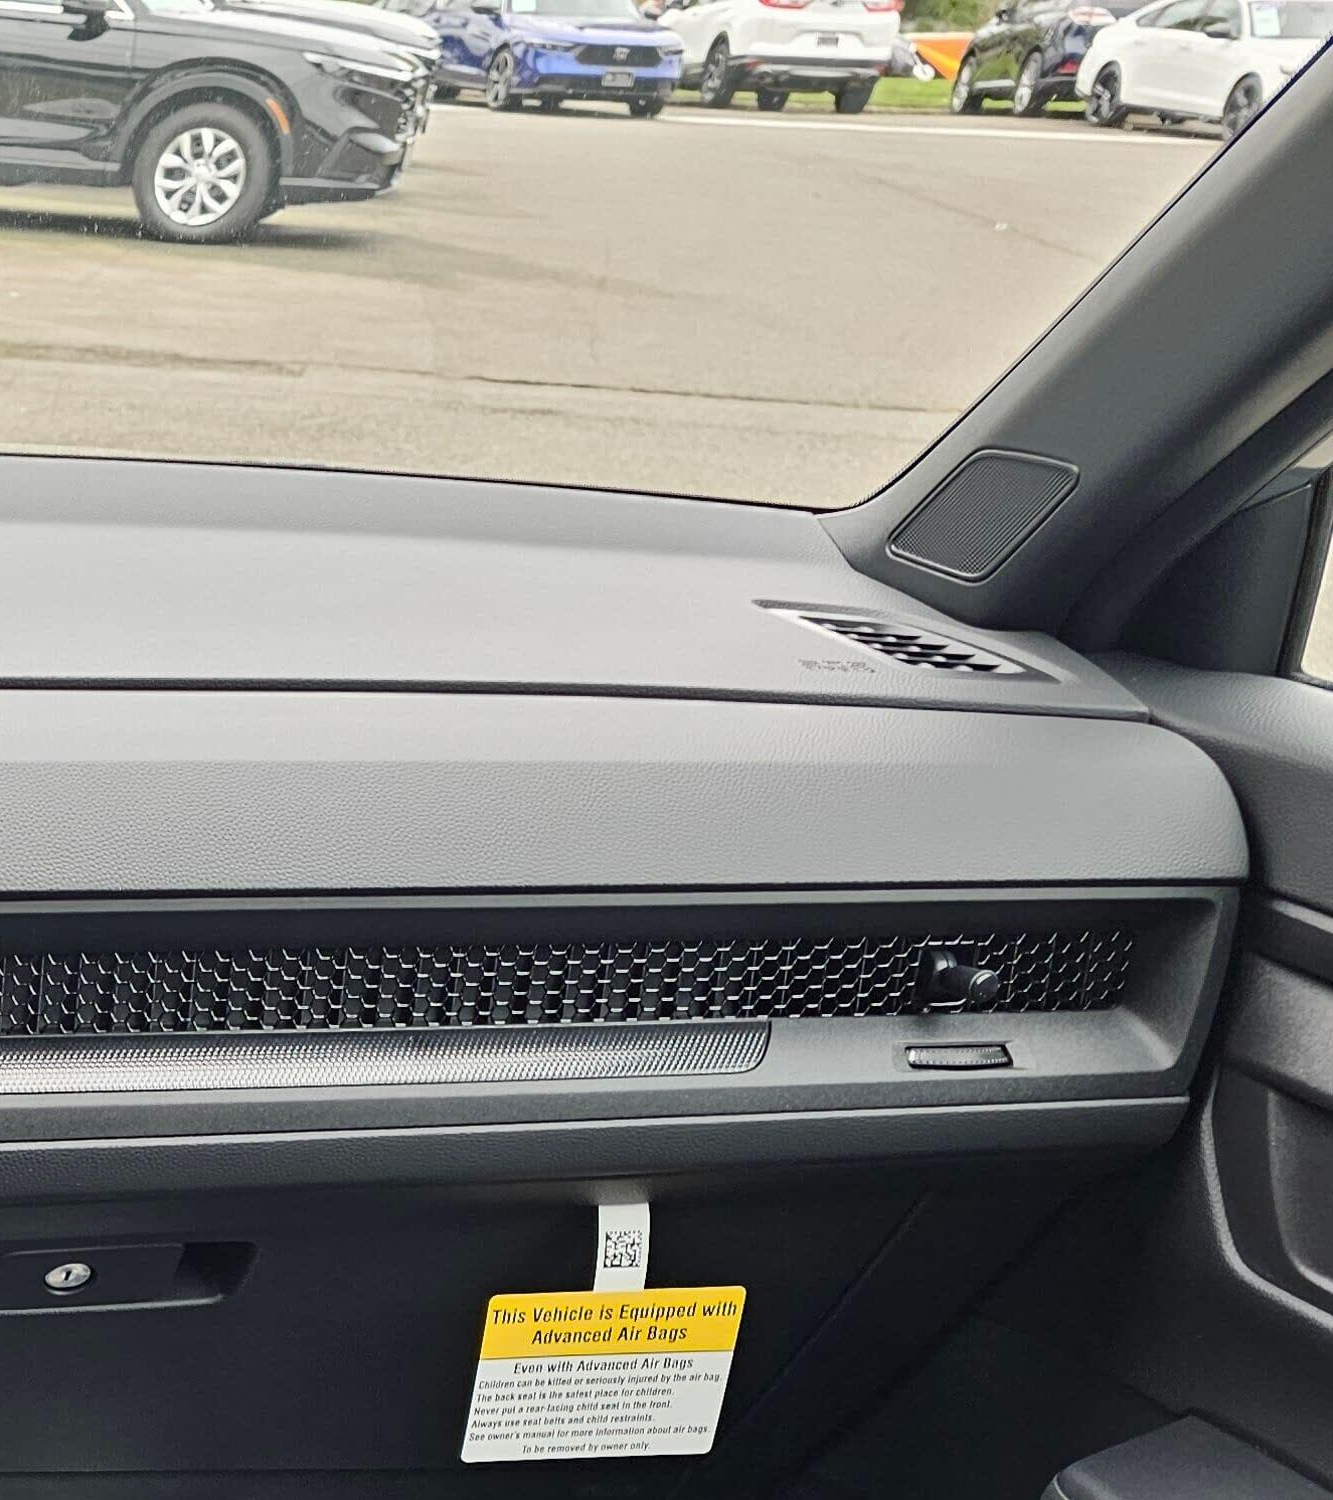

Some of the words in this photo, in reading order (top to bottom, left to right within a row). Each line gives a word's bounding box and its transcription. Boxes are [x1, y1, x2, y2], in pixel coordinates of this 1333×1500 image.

[493, 1309, 526, 1325] This
[533, 1306, 594, 1323] Vehicle
[600, 1305, 614, 1321] is
[619, 1303, 697, 1322] Equipped
[702, 1301, 738, 1317] with
[532, 1327, 612, 1345] Advanced
[617, 1326, 643, 1343] Air
[647, 1325, 688, 1343] Bags
[513, 1363, 543, 1374] Even
[547, 1361, 573, 1373] with
[576, 1358, 638, 1373] Advanced
[641, 1358, 660, 1370] Air
[663, 1357, 694, 1371] Bags
[479, 1379, 514, 1390] Children
[517, 1380, 532, 1388] can
[535, 1378, 545, 1387] be
[547, 1377, 572, 1386] killed
[586, 1375, 625, 1387] seriously
[628, 1374, 659, 1385] injured
[661, 1374, 671, 1384] by
[673, 1373, 686, 1381] the
[689, 1373, 702, 1381] air
[477, 1394, 492, 1403] The
[495, 1392, 515, 1402] back
[518, 1391, 536, 1401] seat
[539, 1391, 546, 1400] is
[549, 1390, 563, 1400] the
[566, 1389, 593, 1399] safest
[594, 1388, 619, 1399] place
[621, 1387, 634, 1397] for
[474, 1407, 499, 1416] Never
[501, 1406, 516, 1417] put
[526, 1403, 574, 1414] rear-facing
[576, 1402, 598, 1411] child
[601, 1401, 620, 1411] seat
[623, 1401, 631, 1410] in
[633, 1399, 647, 1409] the
[471, 1419, 502, 1430] Always
[504, 1419, 520, 1427] use
[523, 1417, 542, 1427] seat
[544, 1416, 565, 1425] belts
[567, 1415, 584, 1424] and
[586, 1414, 608, 1423] child
[469, 1432, 485, 1441] See
[487, 1431, 520, 1441] owner's
[522, 1429, 555, 1440] manual
[556, 1429, 569, 1439] for
[571, 1429, 593, 1437] more
[595, 1426, 645, 1437] information
[647, 1425, 672, 1435] about
[673, 1425, 685, 1434] air
[522, 1445, 532, 1454] To
[534, 1444, 545, 1453] be
[547, 1443, 585, 1453] removed
[588, 1442, 599, 1453] by
[601, 1442, 628, 1451] owner
